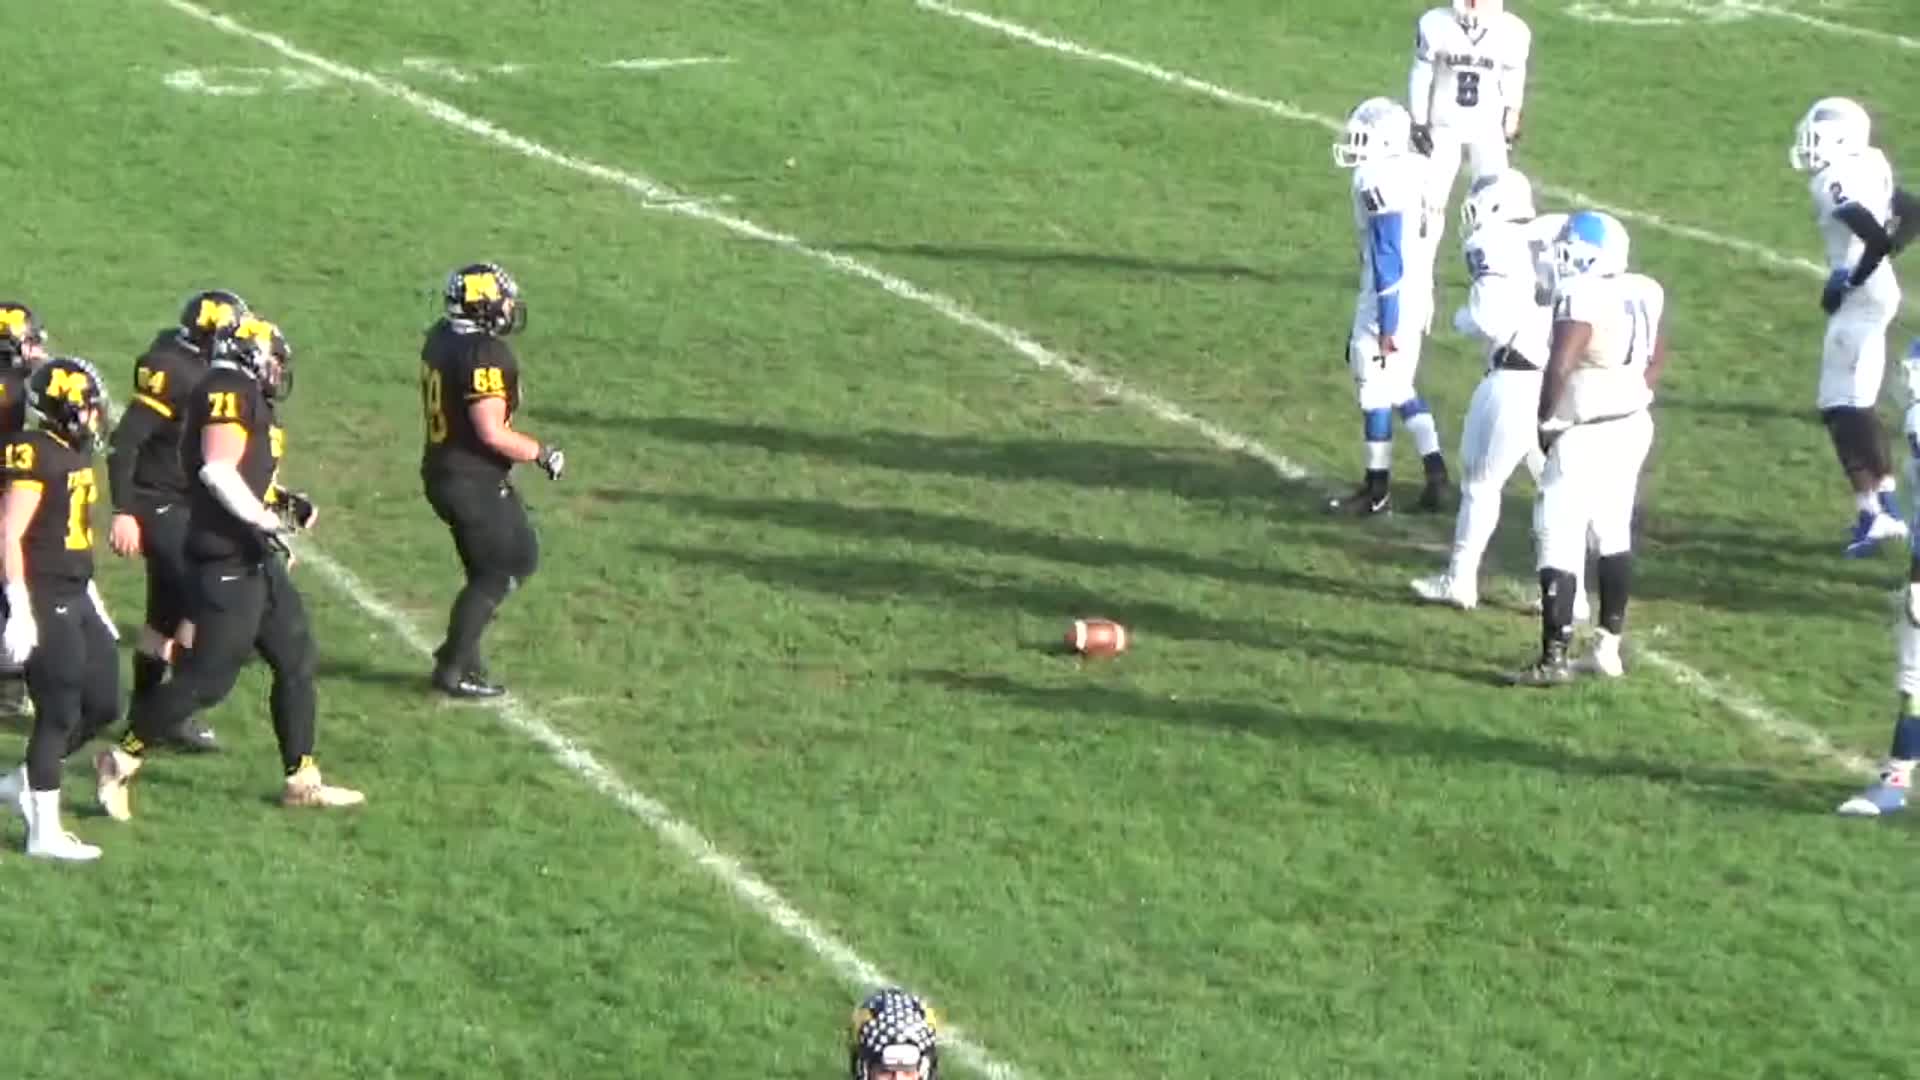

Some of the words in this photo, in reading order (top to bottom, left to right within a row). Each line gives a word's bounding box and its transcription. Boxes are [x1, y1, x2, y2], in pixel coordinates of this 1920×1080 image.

[197, 300, 234, 328] M
[46, 368, 88, 406] M
[208, 392, 239, 418] 71
[5, 443, 34, 469] 13
